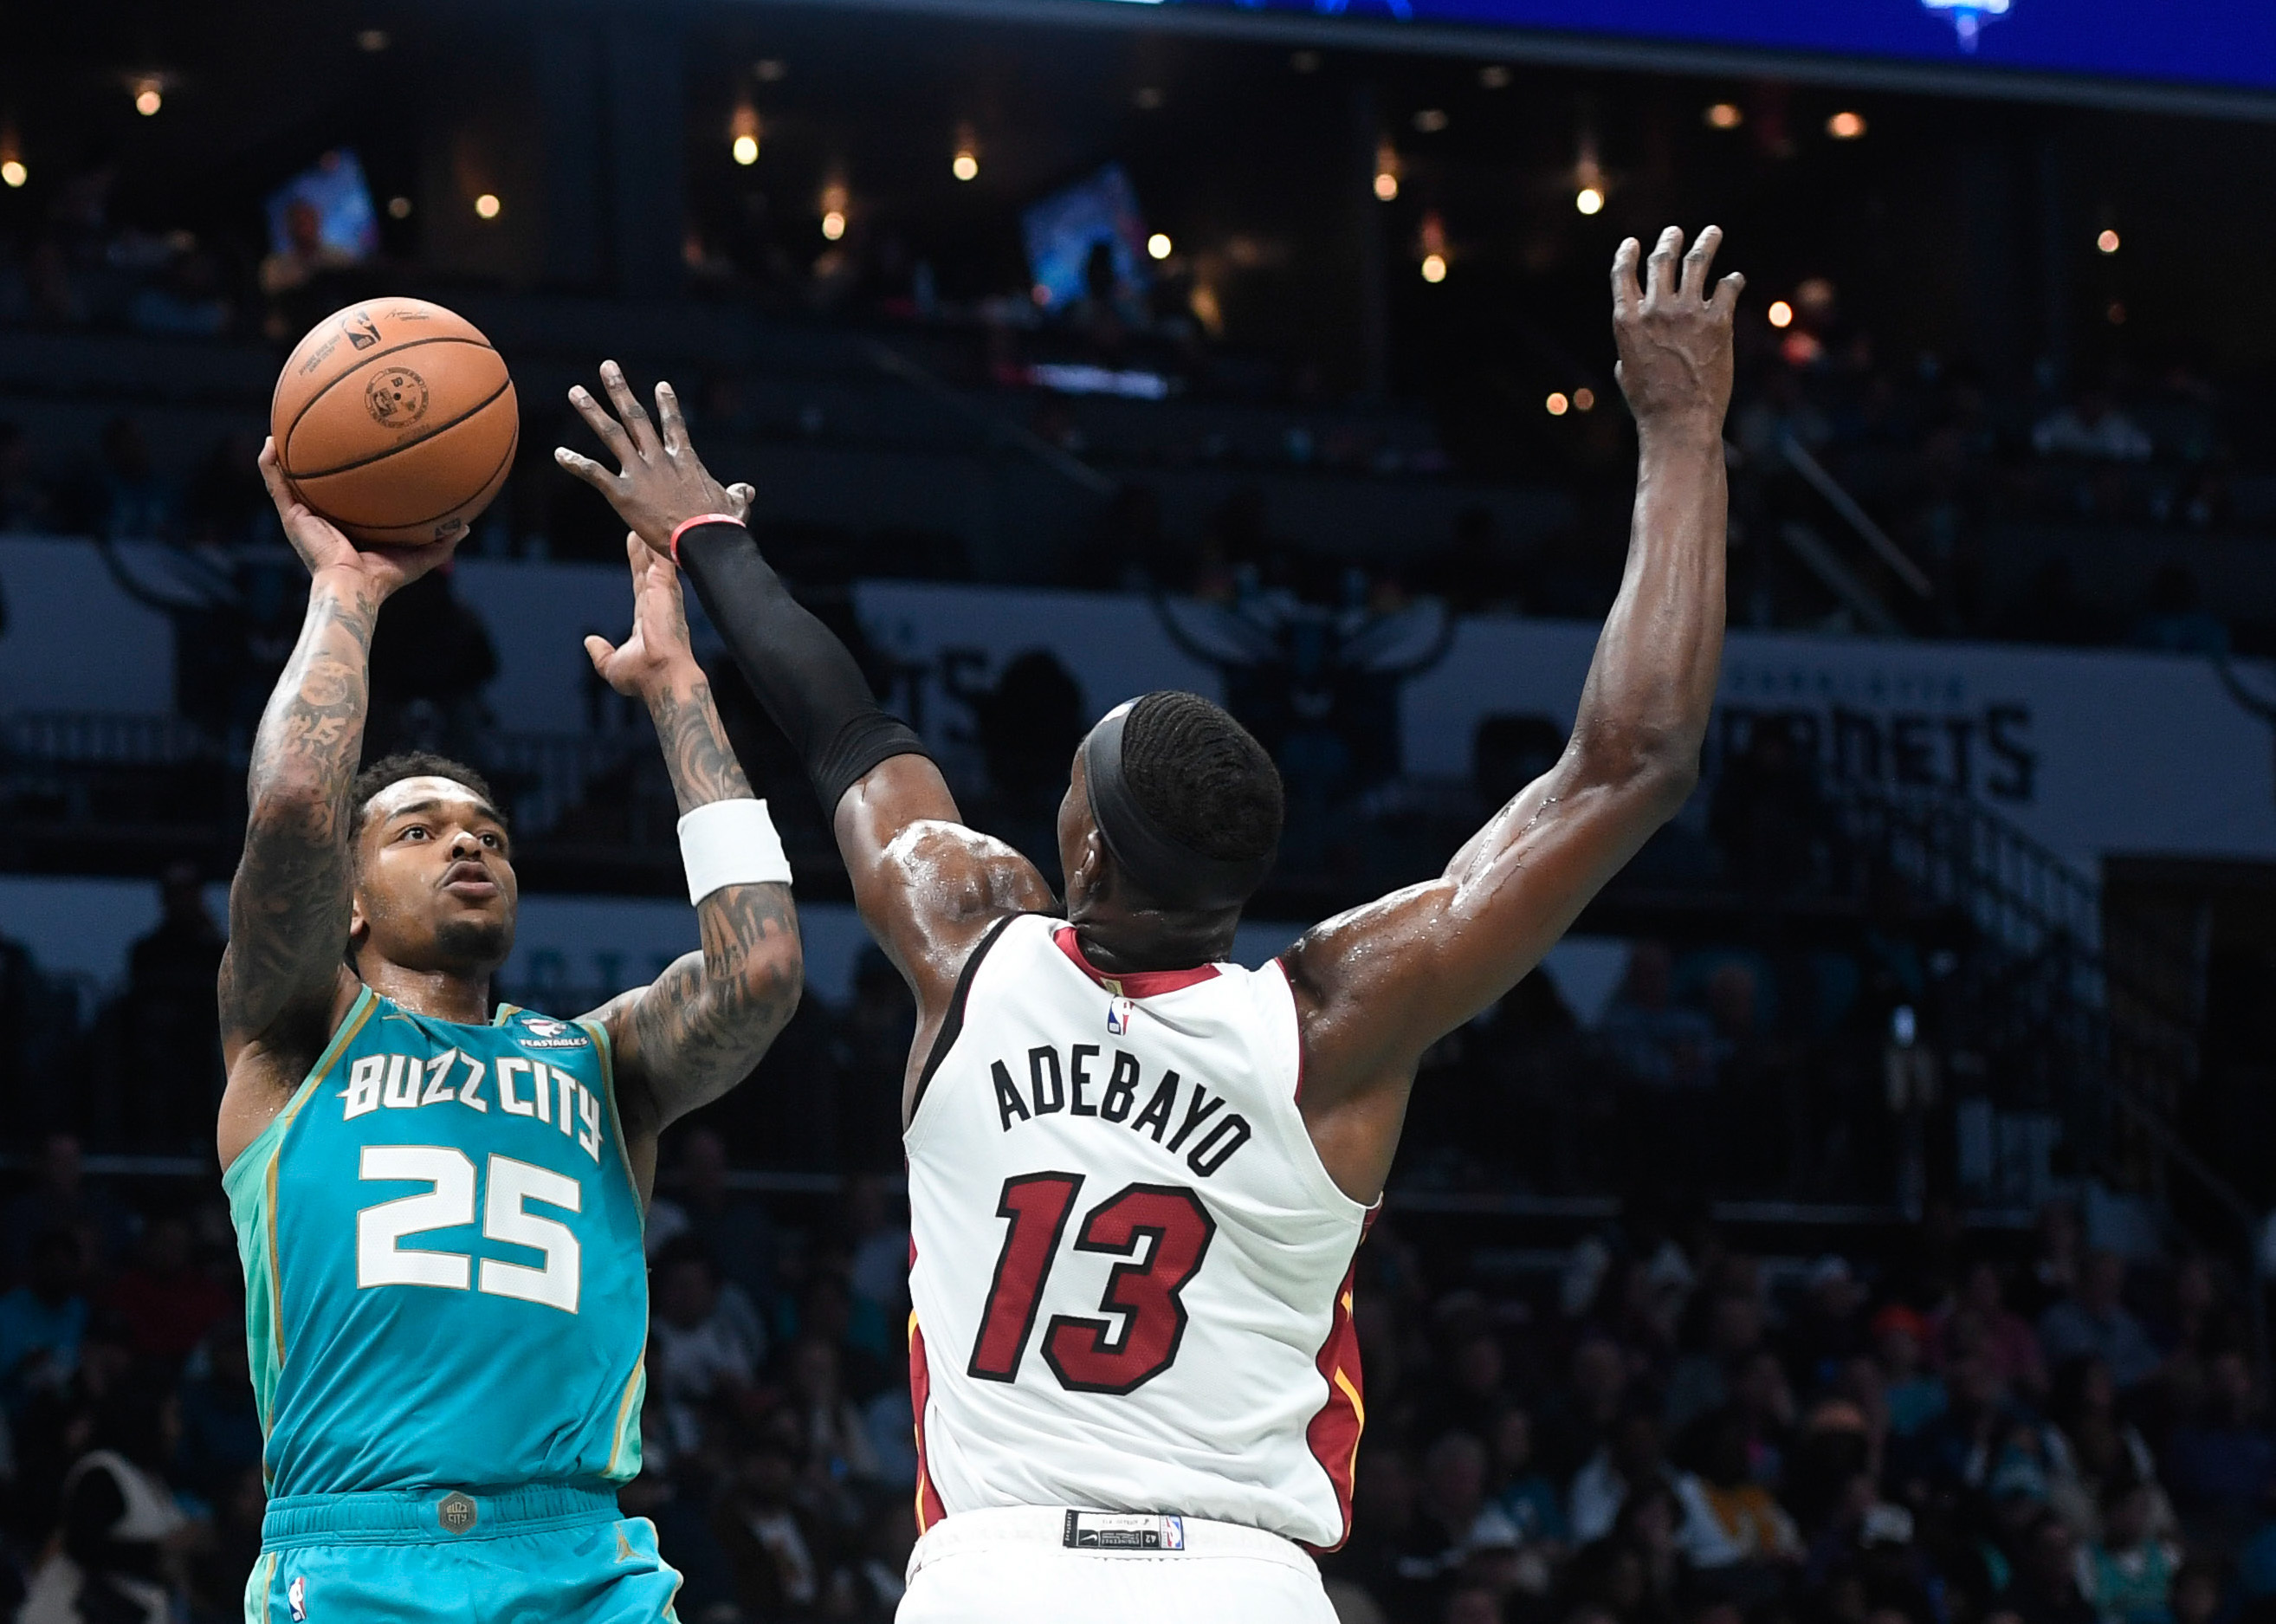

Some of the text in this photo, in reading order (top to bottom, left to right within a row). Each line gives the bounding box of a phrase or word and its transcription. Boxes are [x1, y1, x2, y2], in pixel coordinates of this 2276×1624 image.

[336, 1047, 604, 1163] BUZZ CITY
[519, 1038, 588, 1047] FEASTABLES
[990, 1044, 1251, 1178] ADEBAYO
[356, 1144, 581, 1315] 25
[967, 1170, 1218, 1396] 13
[448, 1513, 467, 1524] CITY
